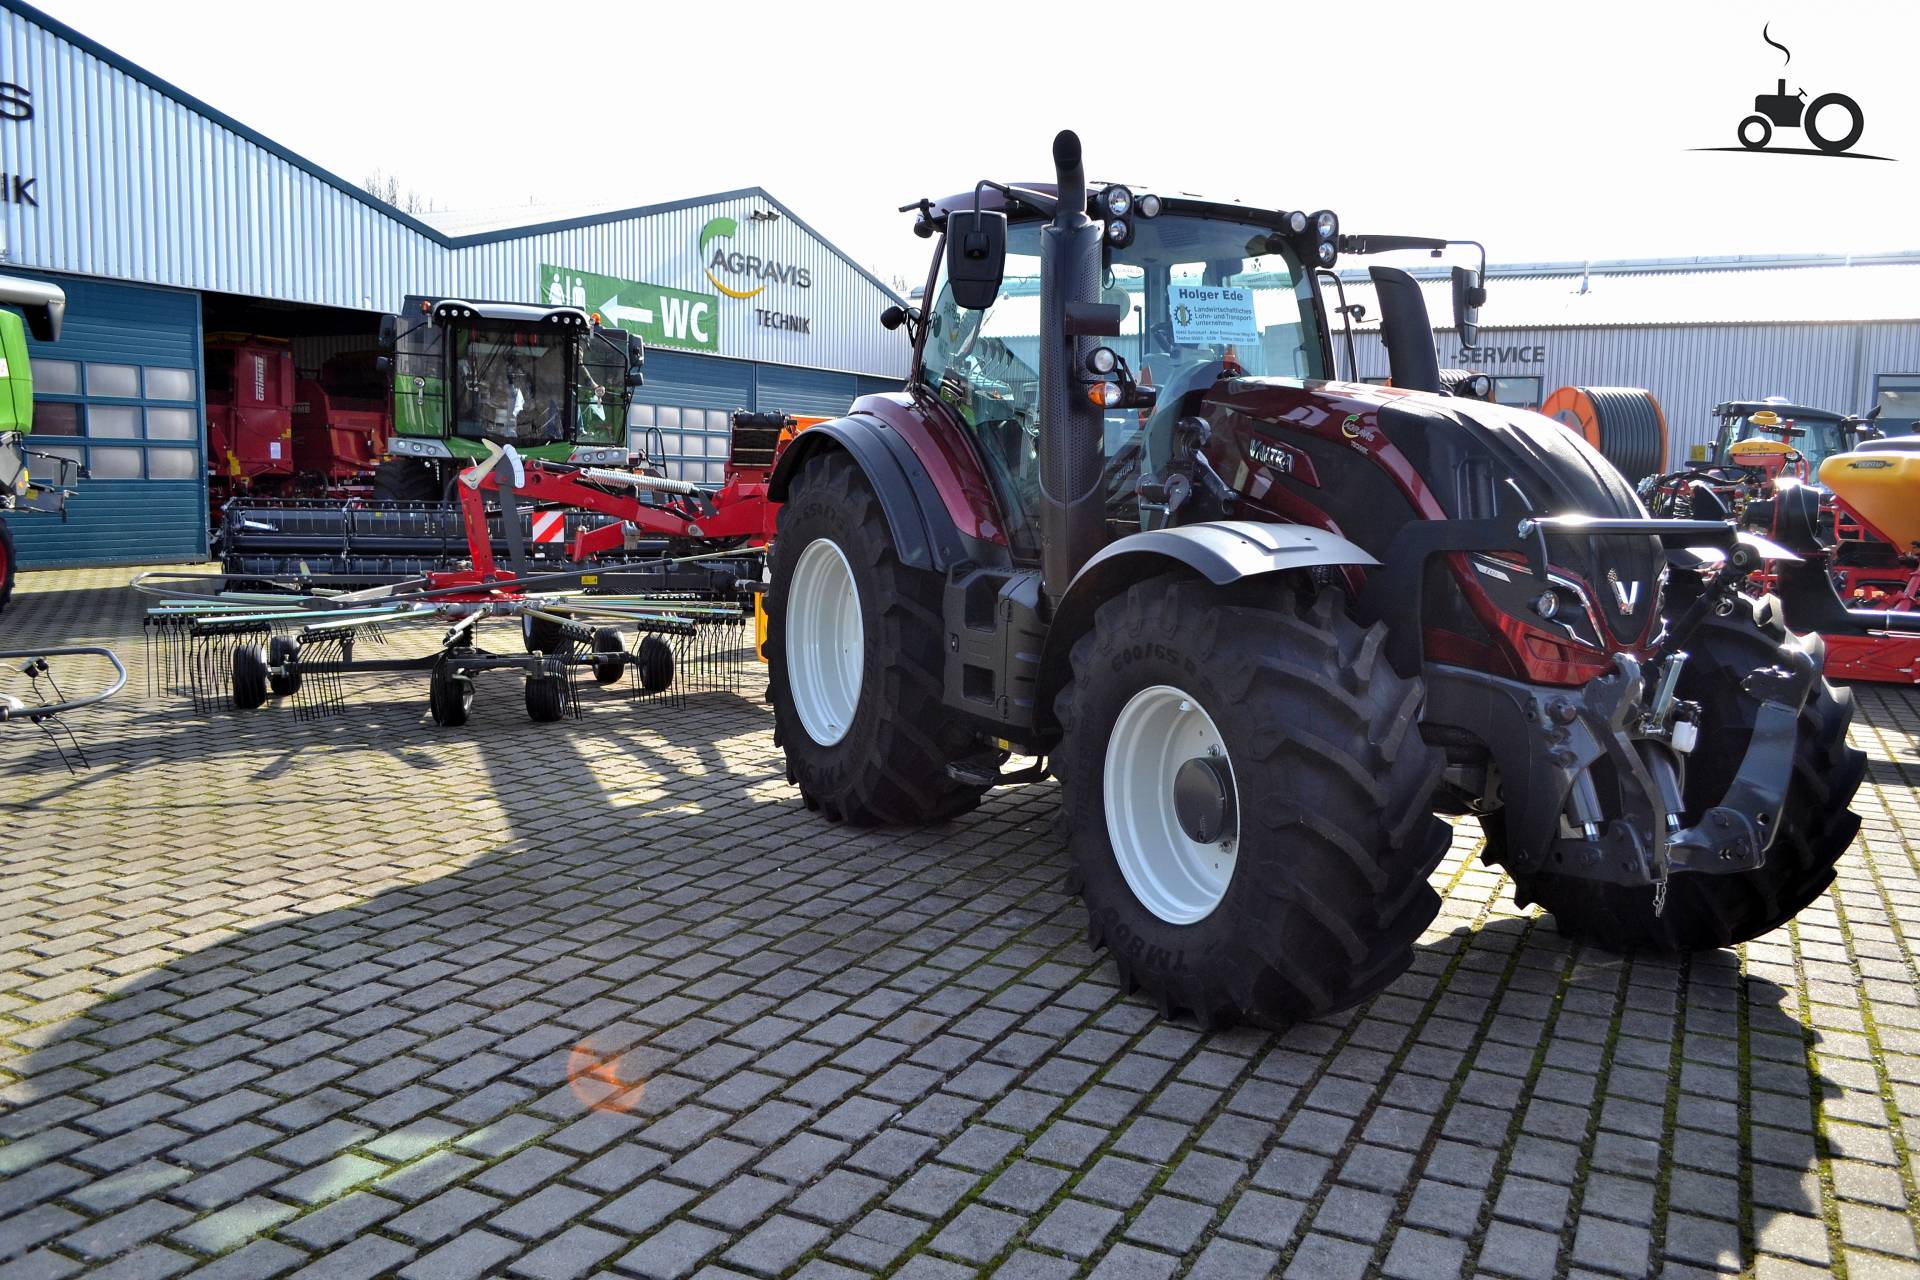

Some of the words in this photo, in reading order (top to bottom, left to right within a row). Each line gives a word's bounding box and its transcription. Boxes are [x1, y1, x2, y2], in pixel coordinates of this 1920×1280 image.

[710, 248, 812, 289] AGRAVIS
[1178, 288, 1219, 301] Holger
[1222, 290, 1244, 301] Ede
[660, 295, 709, 343] WC
[755, 308, 811, 335] TECHNIK
[1194, 306, 1252, 315] Landwirtschaftliches
[1226, 313, 1253, 322] Transport-
[257, 356, 265, 402] GRIMME
[1250, 439, 1294, 473] VALTRA
